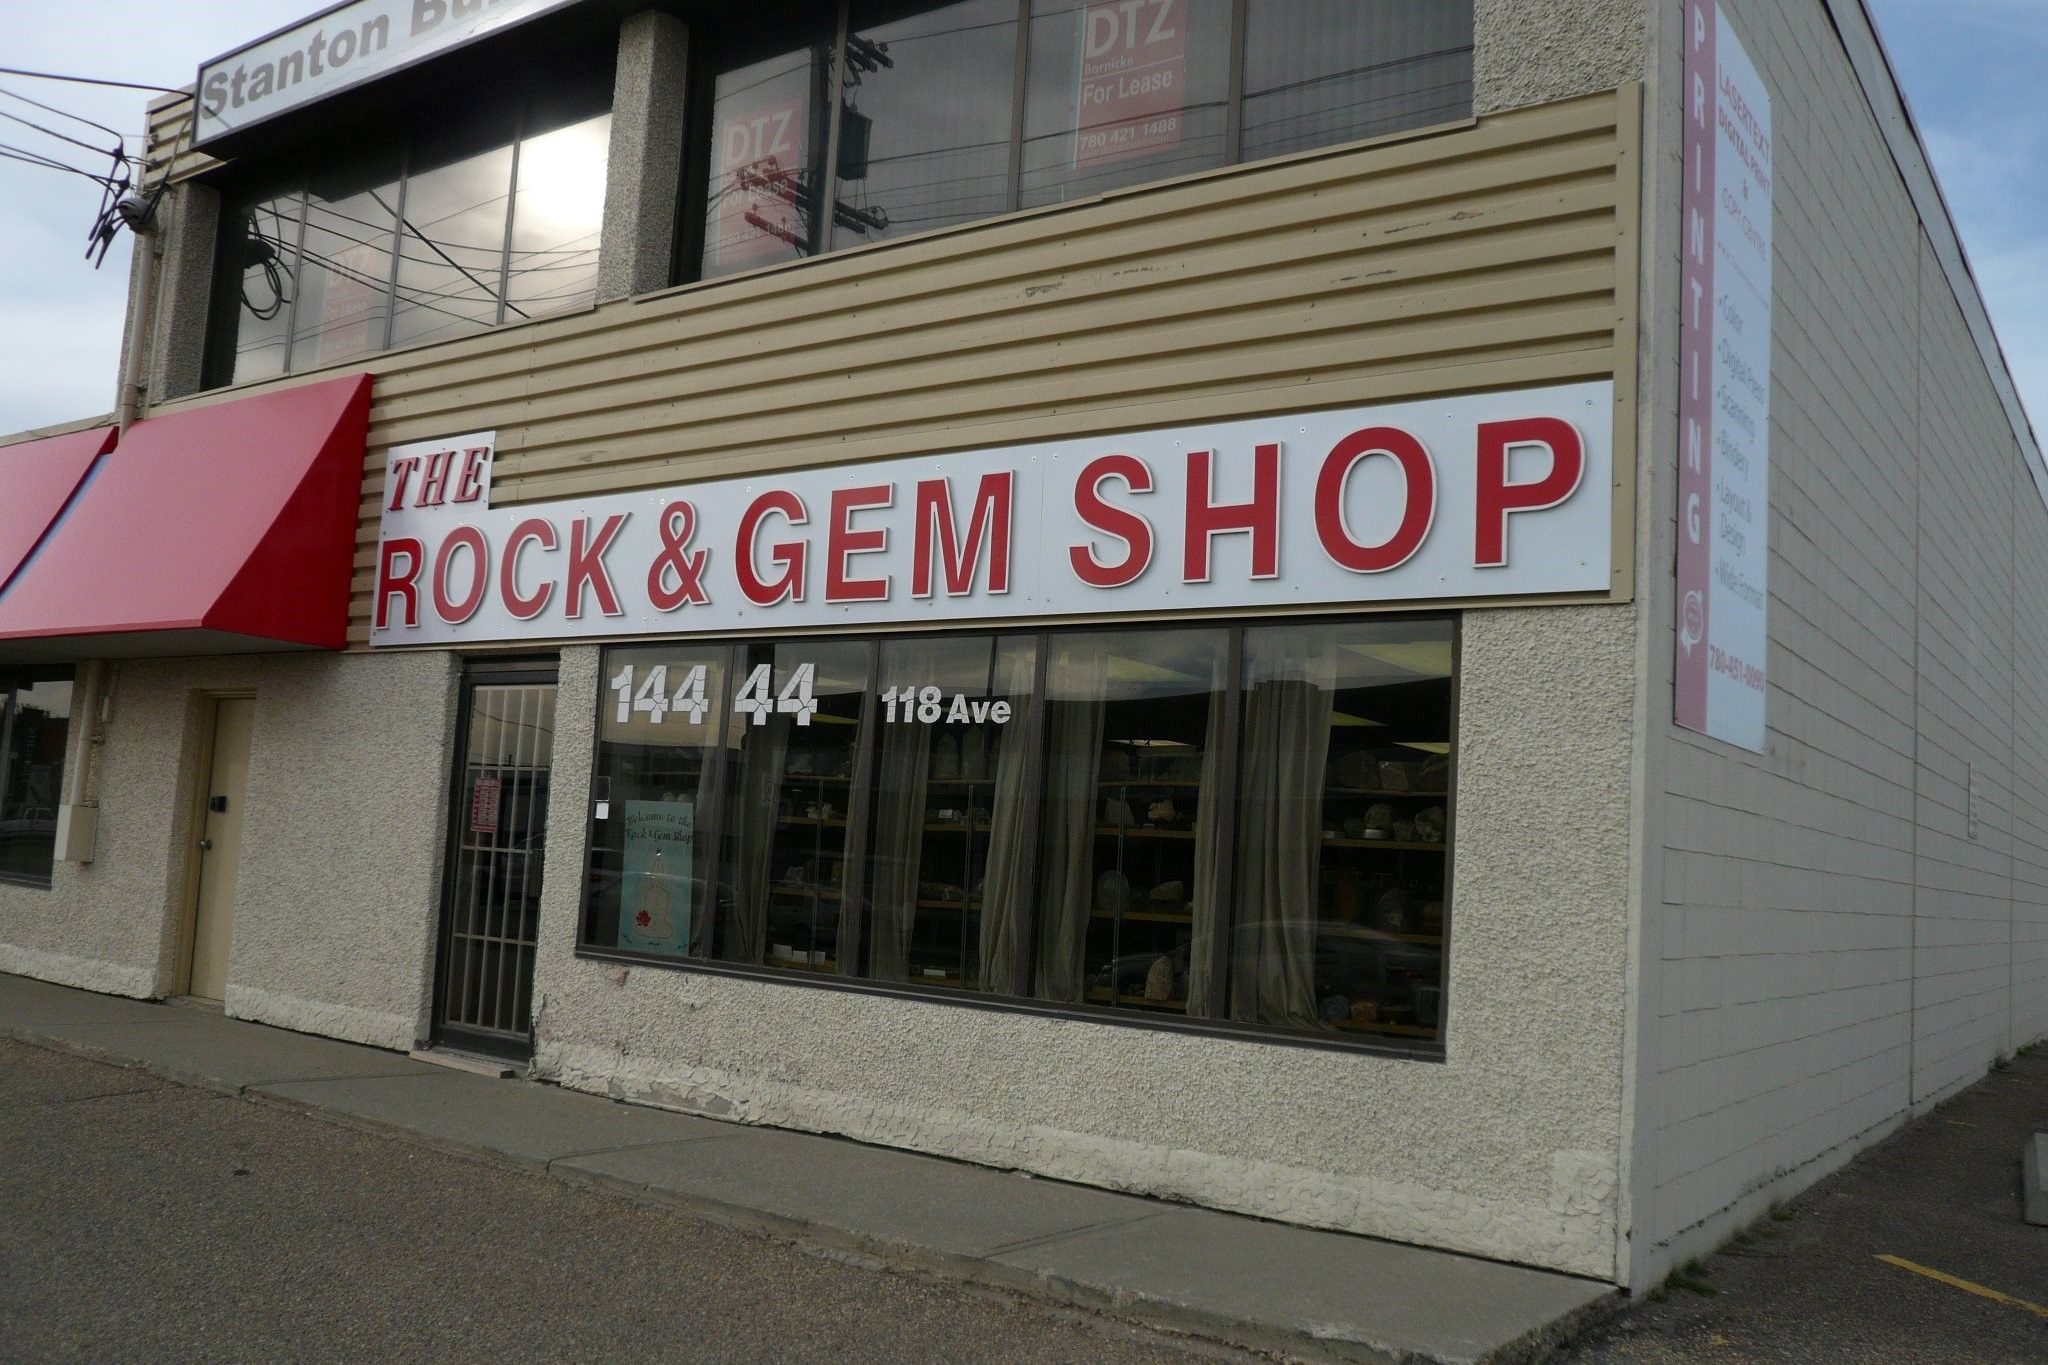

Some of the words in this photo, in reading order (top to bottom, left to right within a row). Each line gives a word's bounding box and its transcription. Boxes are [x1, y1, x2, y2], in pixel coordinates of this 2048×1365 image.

[1086, 0, 1175, 57] DTZ
[201, 13, 389, 120] Stanton
[1083, 83, 1113, 107] For
[1118, 69, 1173, 98] Lease
[726, 108, 794, 166] DTZ
[1080, 132, 1106, 150] 780
[1110, 127, 1135, 143] 421
[1719, 63, 1769, 165] LASERTEXT
[387, 446, 490, 513] THE
[376, 511, 632, 631] ROCK
[646, 499, 713, 613] &
[735, 470, 1016, 607] GEM
[1069, 416, 1585, 588] SHOP
[880, 686, 942, 725] 118
[946, 693, 1012, 725] Ave
